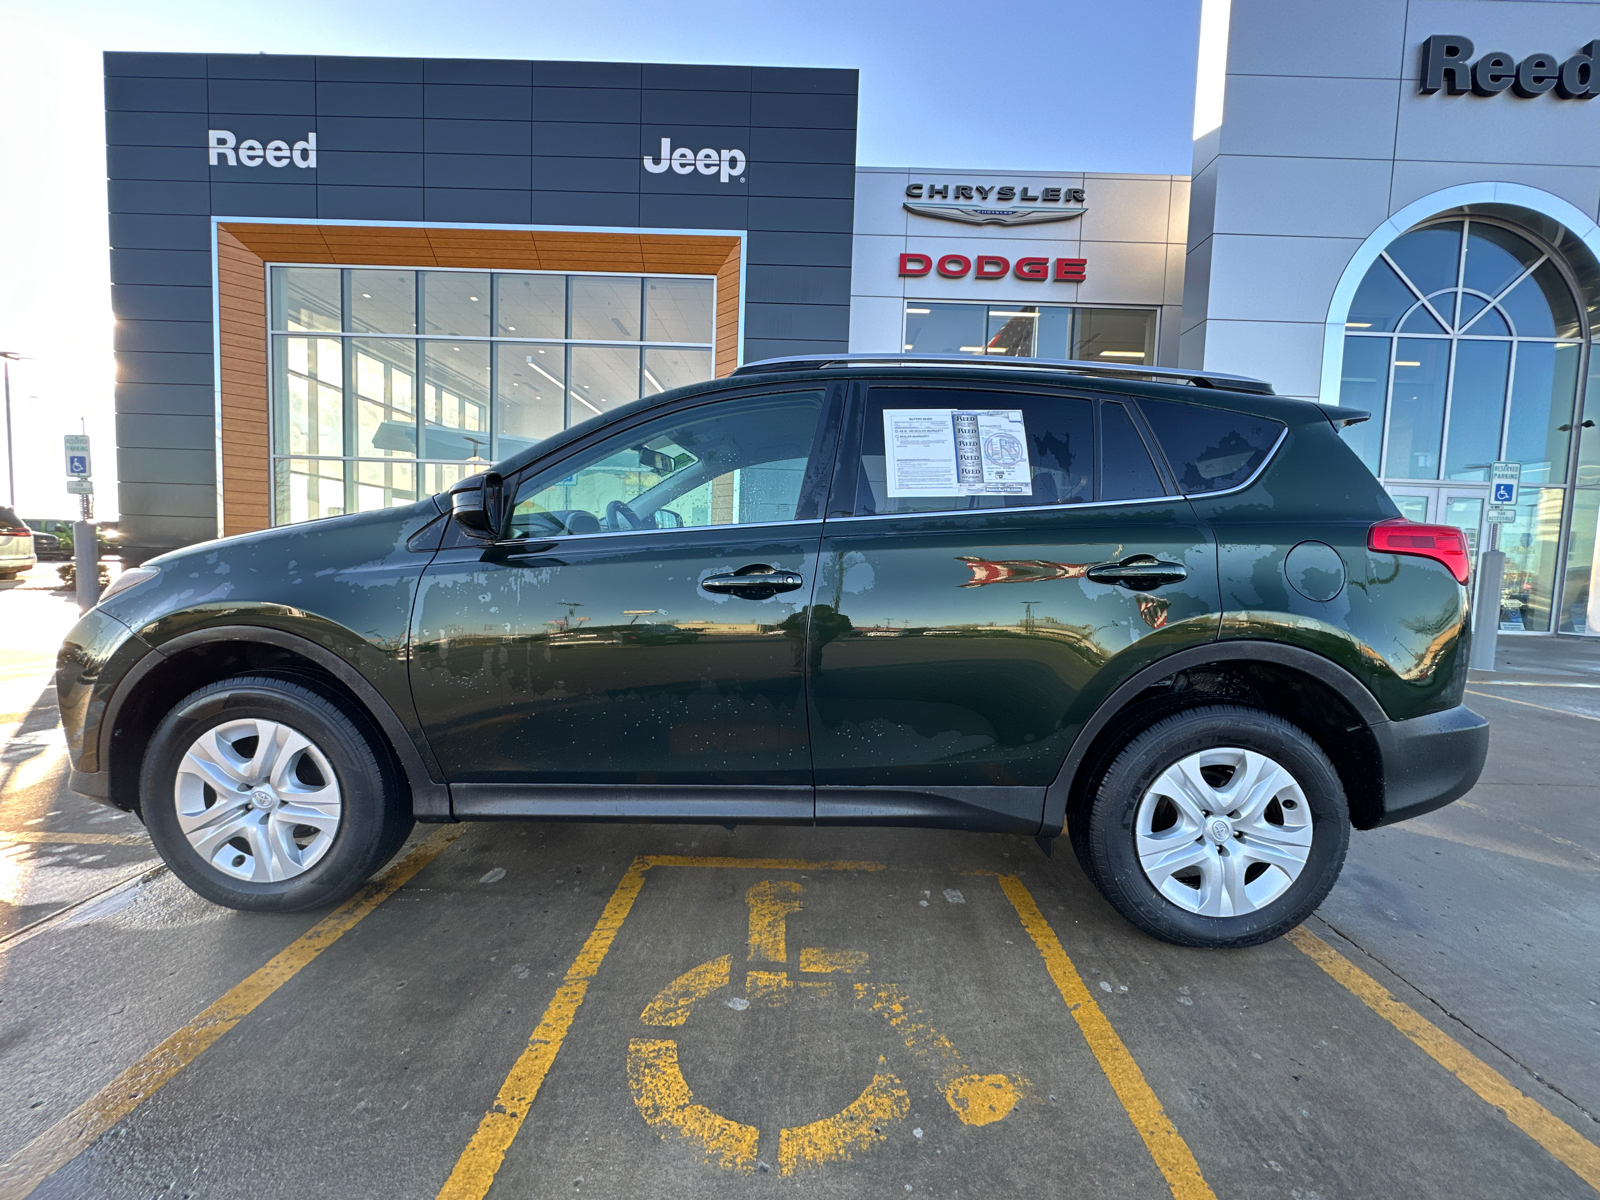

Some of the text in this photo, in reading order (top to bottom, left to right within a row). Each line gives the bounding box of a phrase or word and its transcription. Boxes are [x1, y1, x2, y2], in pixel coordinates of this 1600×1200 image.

[1419, 34, 1600, 99] Reed
[208, 129, 317, 168] Reed
[643, 137, 746, 183] Jeep
[905, 183, 1085, 202] CHRYSLER
[898, 253, 1087, 282] DODGE
[1493, 472, 1518, 480] PARKING
